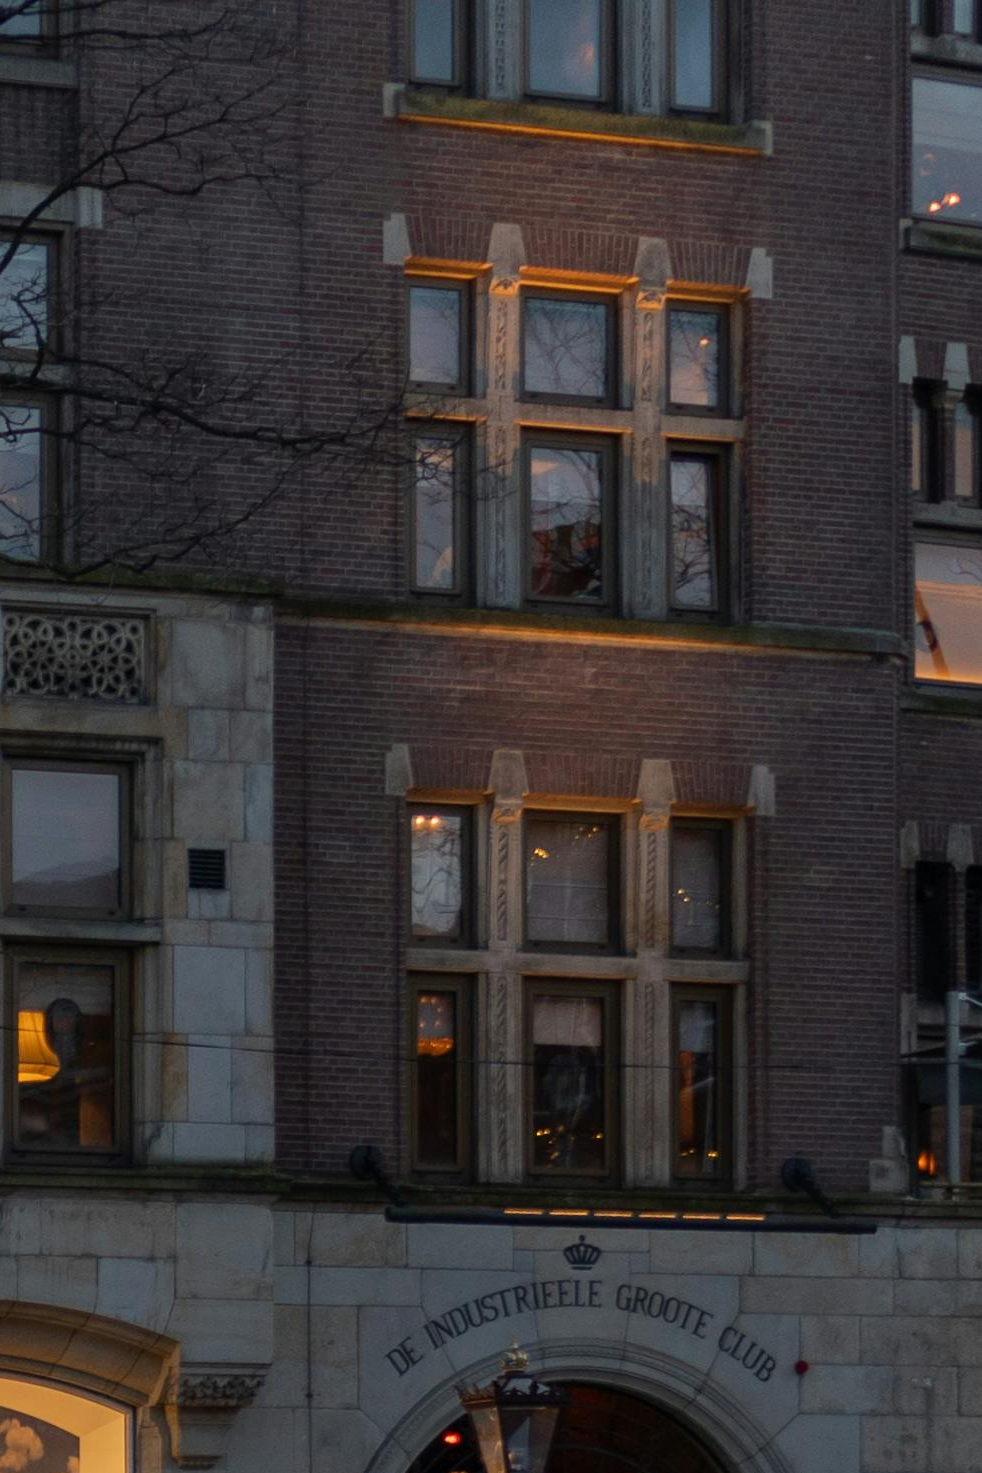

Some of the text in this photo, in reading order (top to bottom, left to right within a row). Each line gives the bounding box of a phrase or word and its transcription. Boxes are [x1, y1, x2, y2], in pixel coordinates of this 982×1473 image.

[386, 1279, 777, 1383] DE INDUSTRIEELE GROOTE CLUB
